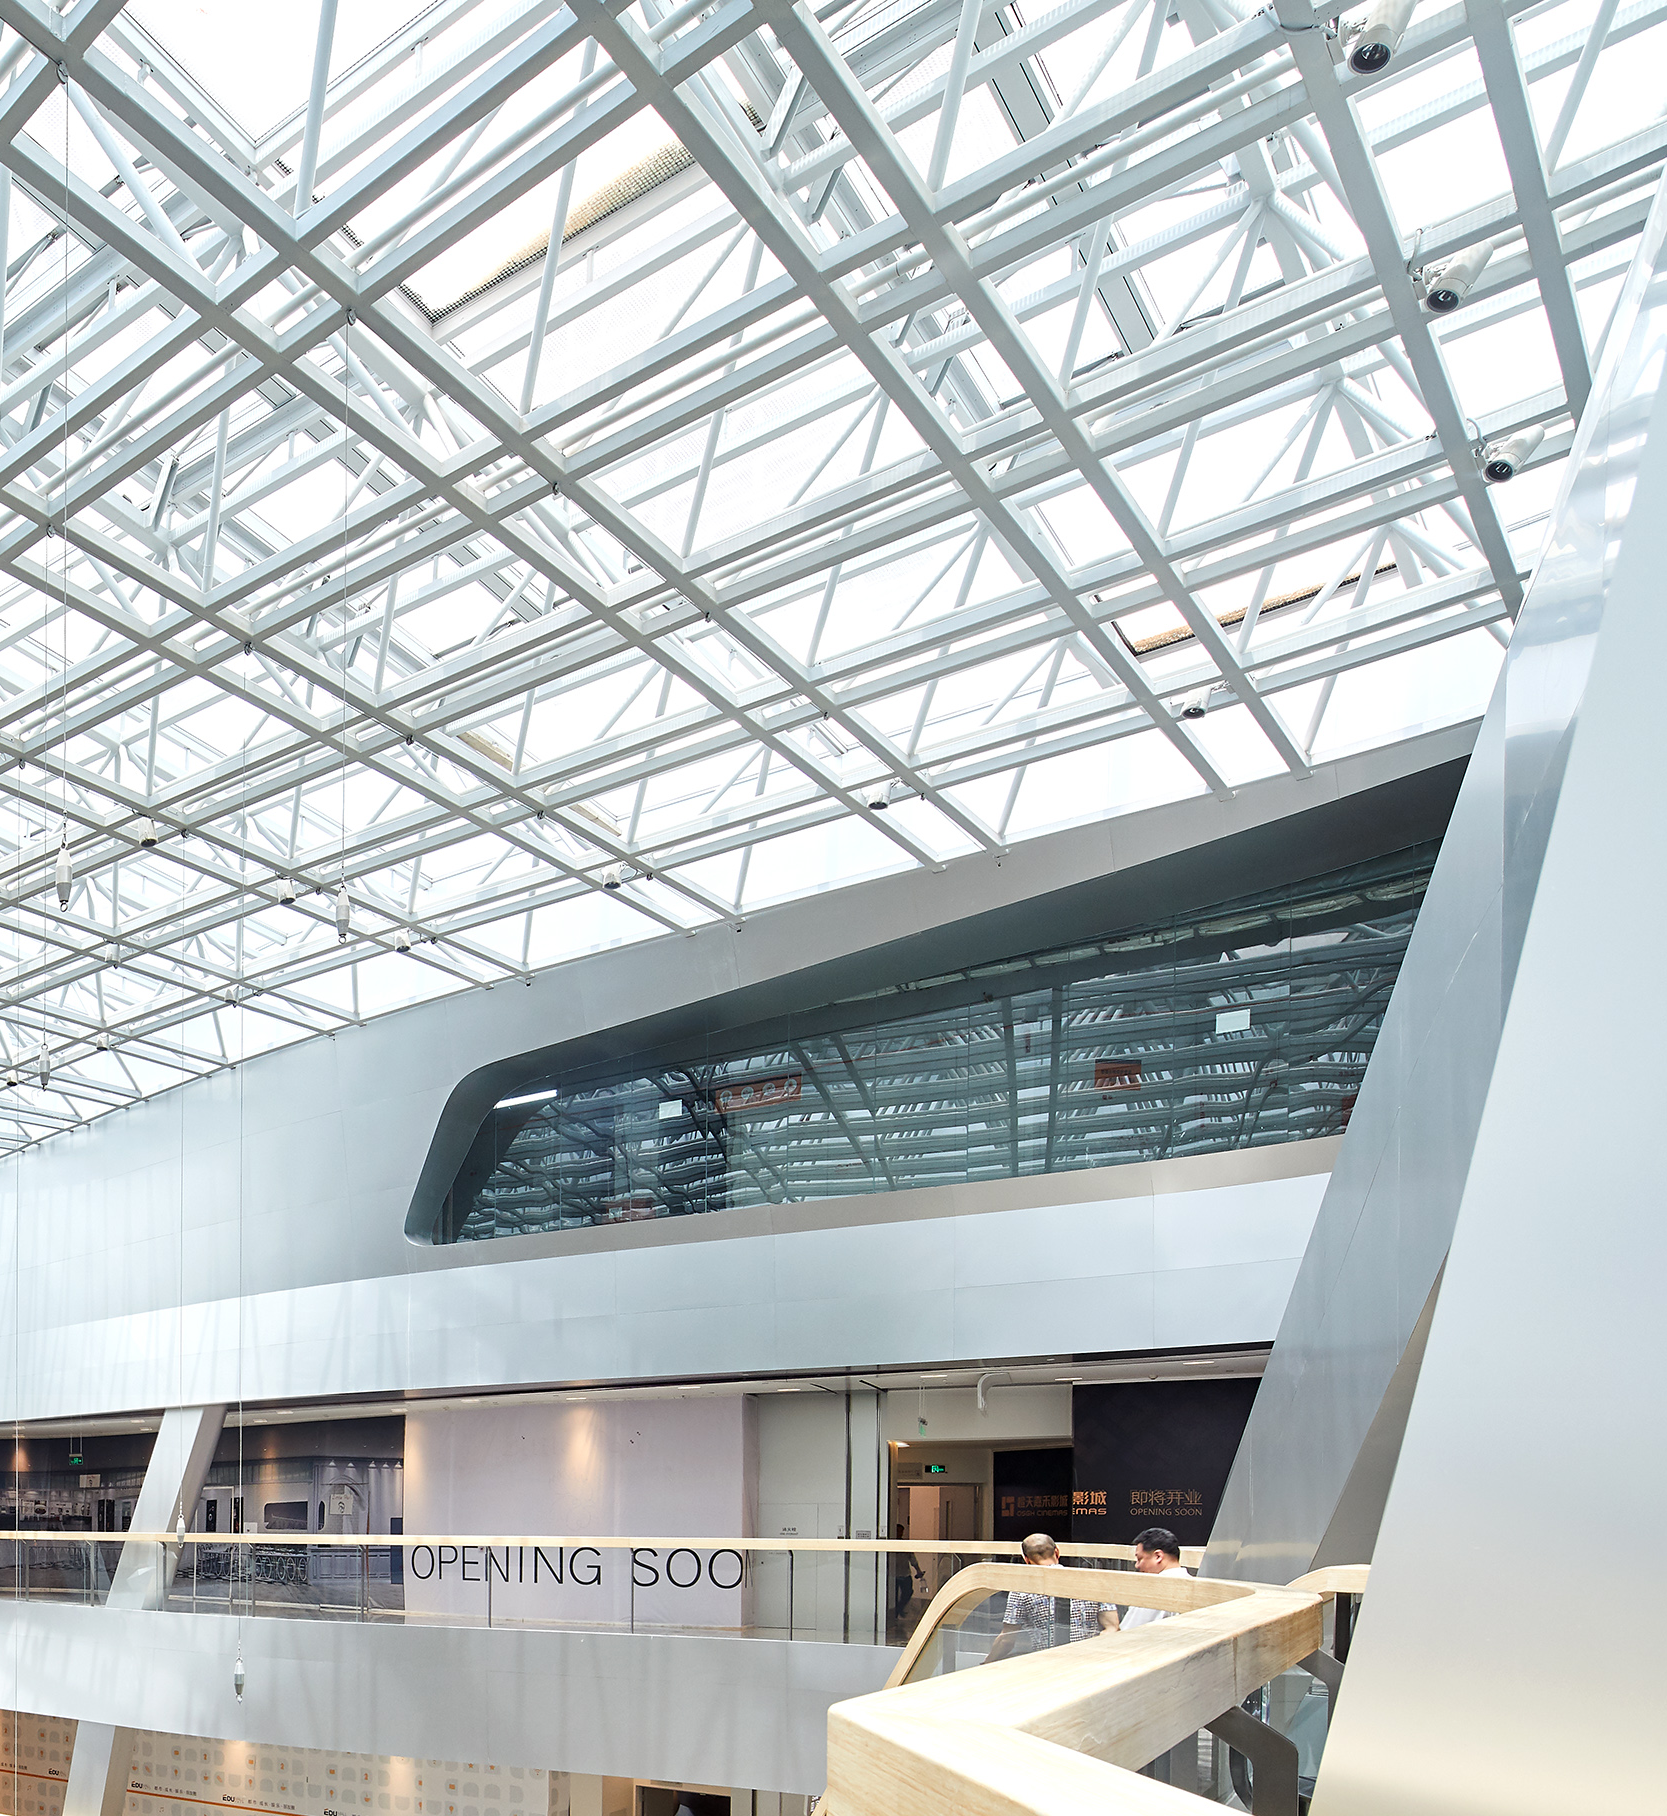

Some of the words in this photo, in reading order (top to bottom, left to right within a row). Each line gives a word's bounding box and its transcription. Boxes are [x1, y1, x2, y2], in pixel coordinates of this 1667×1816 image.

[1129, 1507, 1173, 1516] OPENING
[1175, 1507, 1203, 1516] SOON
[411, 1545, 602, 1586] OPENING
